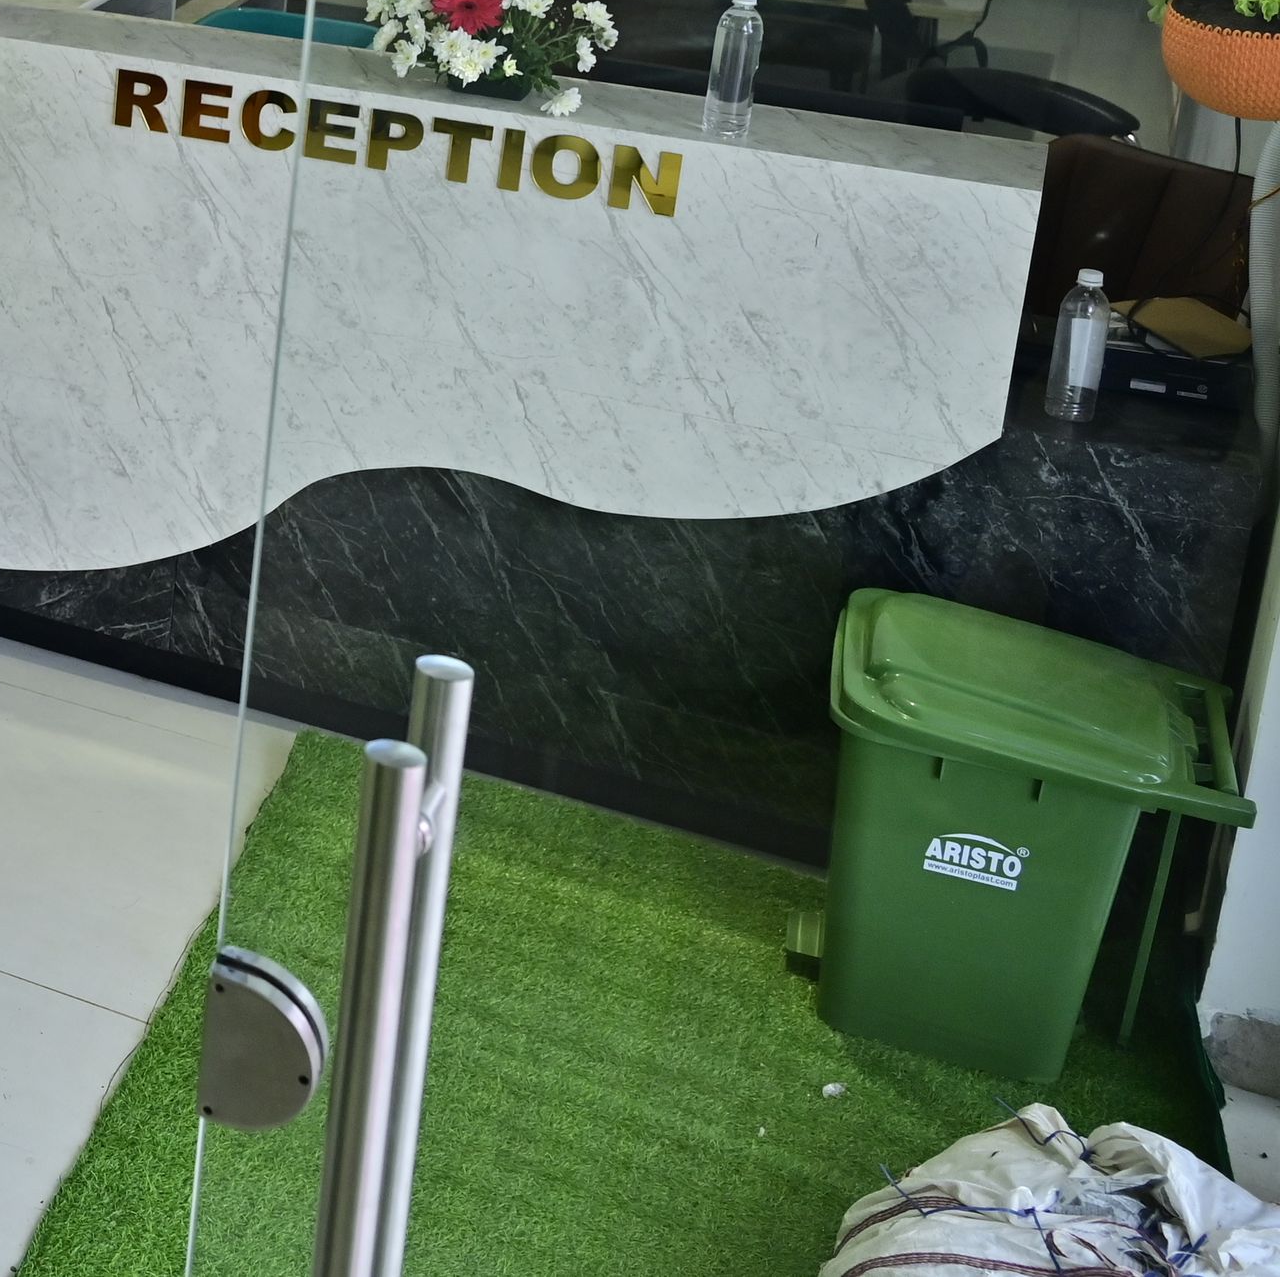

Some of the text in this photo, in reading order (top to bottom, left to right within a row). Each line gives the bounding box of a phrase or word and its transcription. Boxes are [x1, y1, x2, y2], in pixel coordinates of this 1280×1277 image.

[113, 67, 684, 218] RECEPTION
[924, 837, 1023, 879] ARISTO
[926, 860, 1015, 889] www.aristoplast.com
